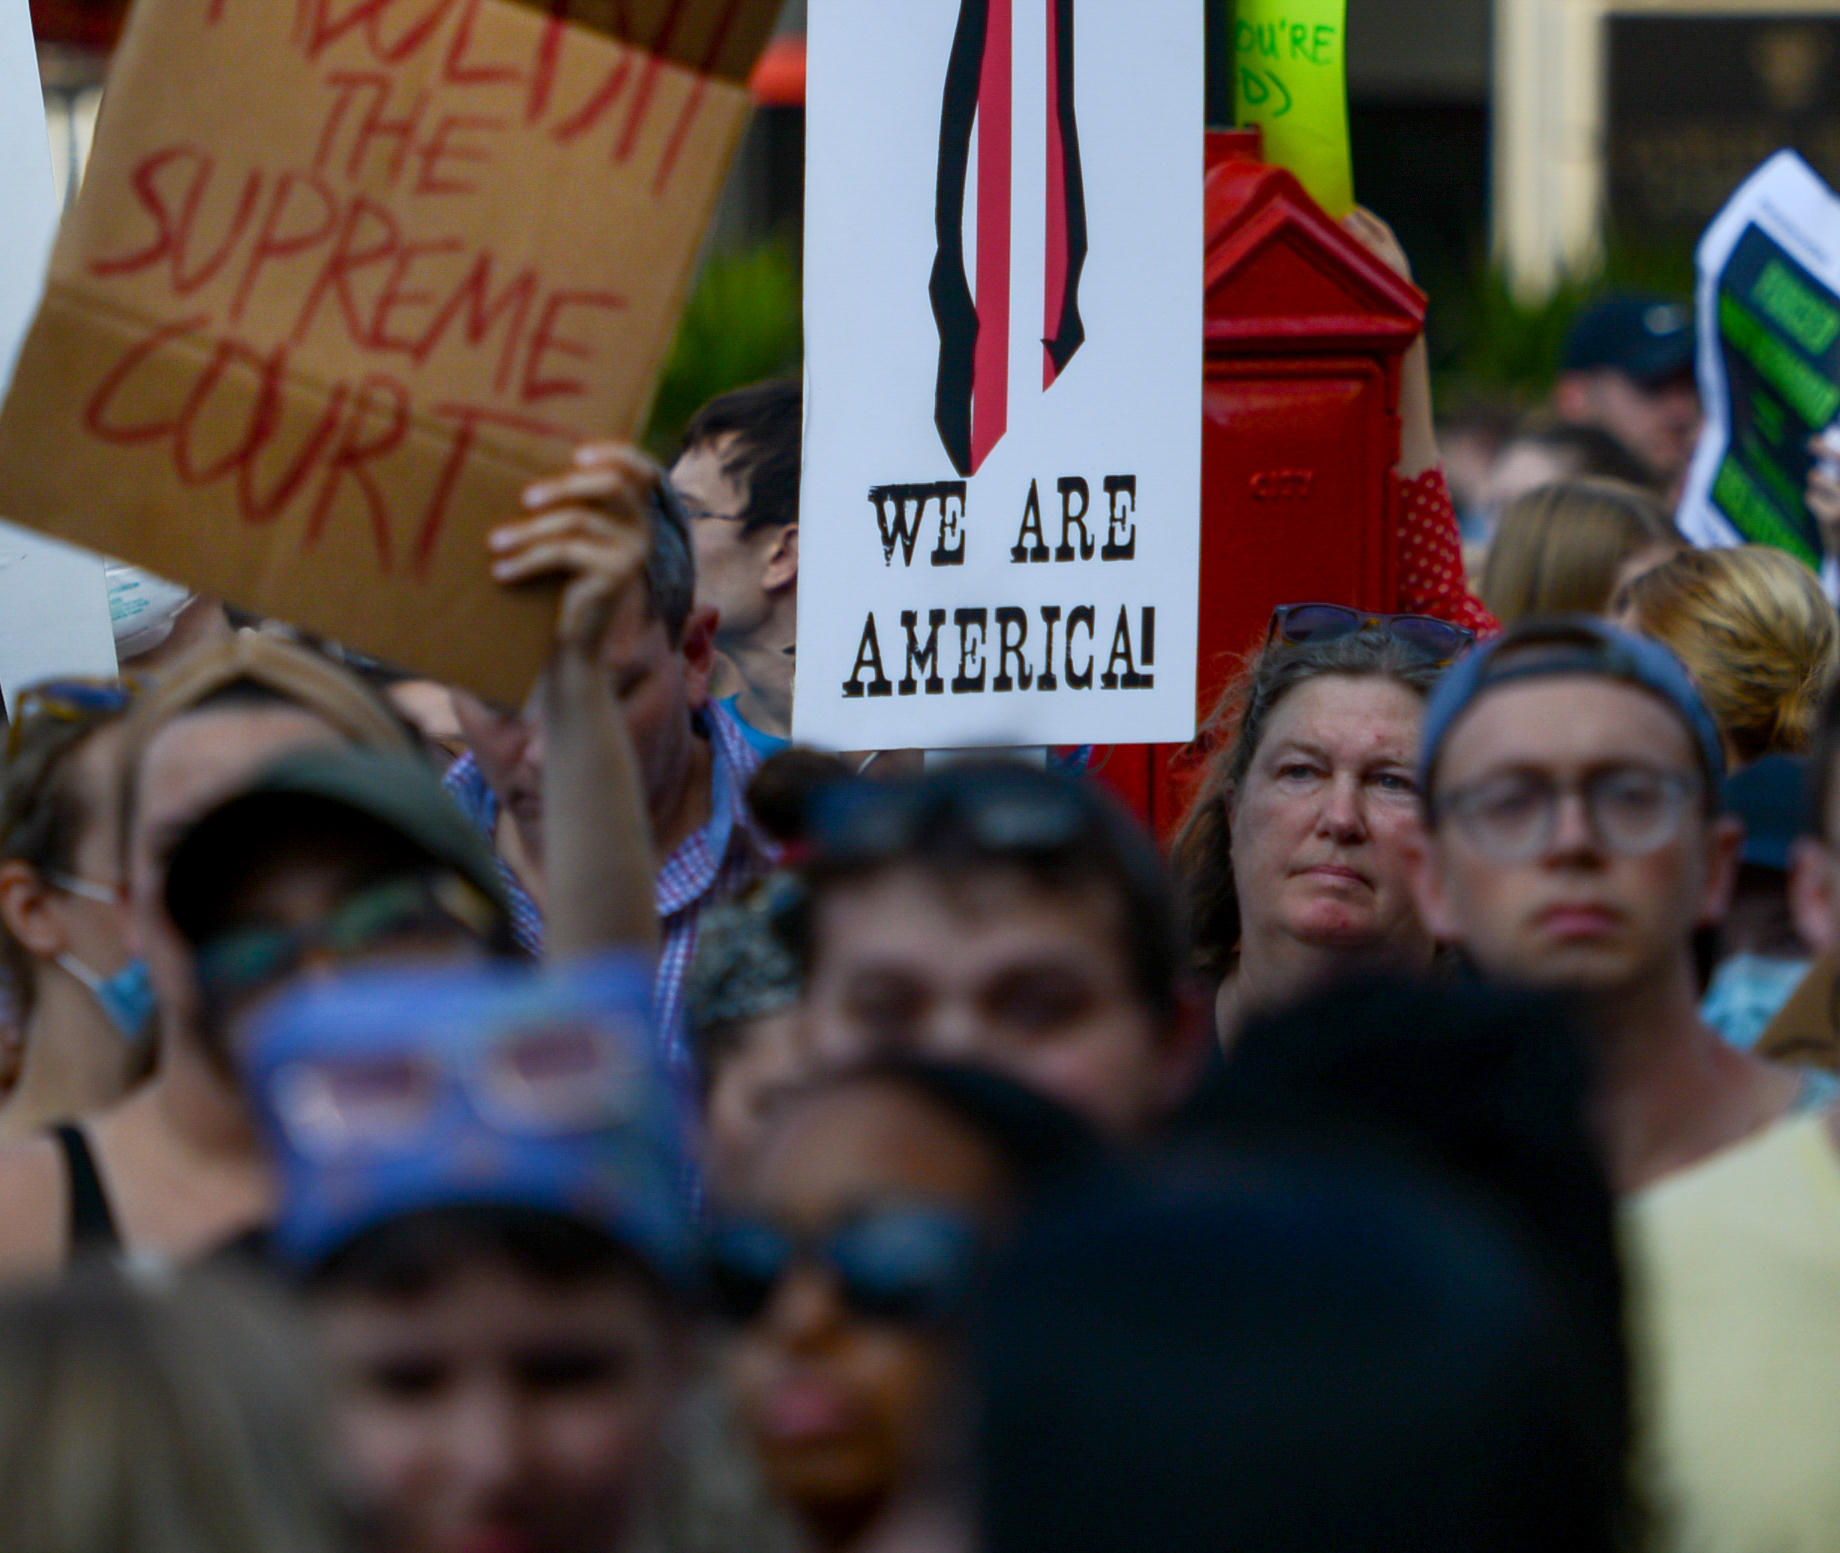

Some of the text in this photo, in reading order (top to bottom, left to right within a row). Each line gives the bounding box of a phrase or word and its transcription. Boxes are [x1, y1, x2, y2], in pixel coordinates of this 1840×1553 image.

[315, 70, 512, 196] THE
[91, 143, 629, 404] SUPREME
[83, 316, 588, 581] COURT
[868, 474, 1137, 567] WE ARE
[842, 603, 1156, 698] AMERICA!
